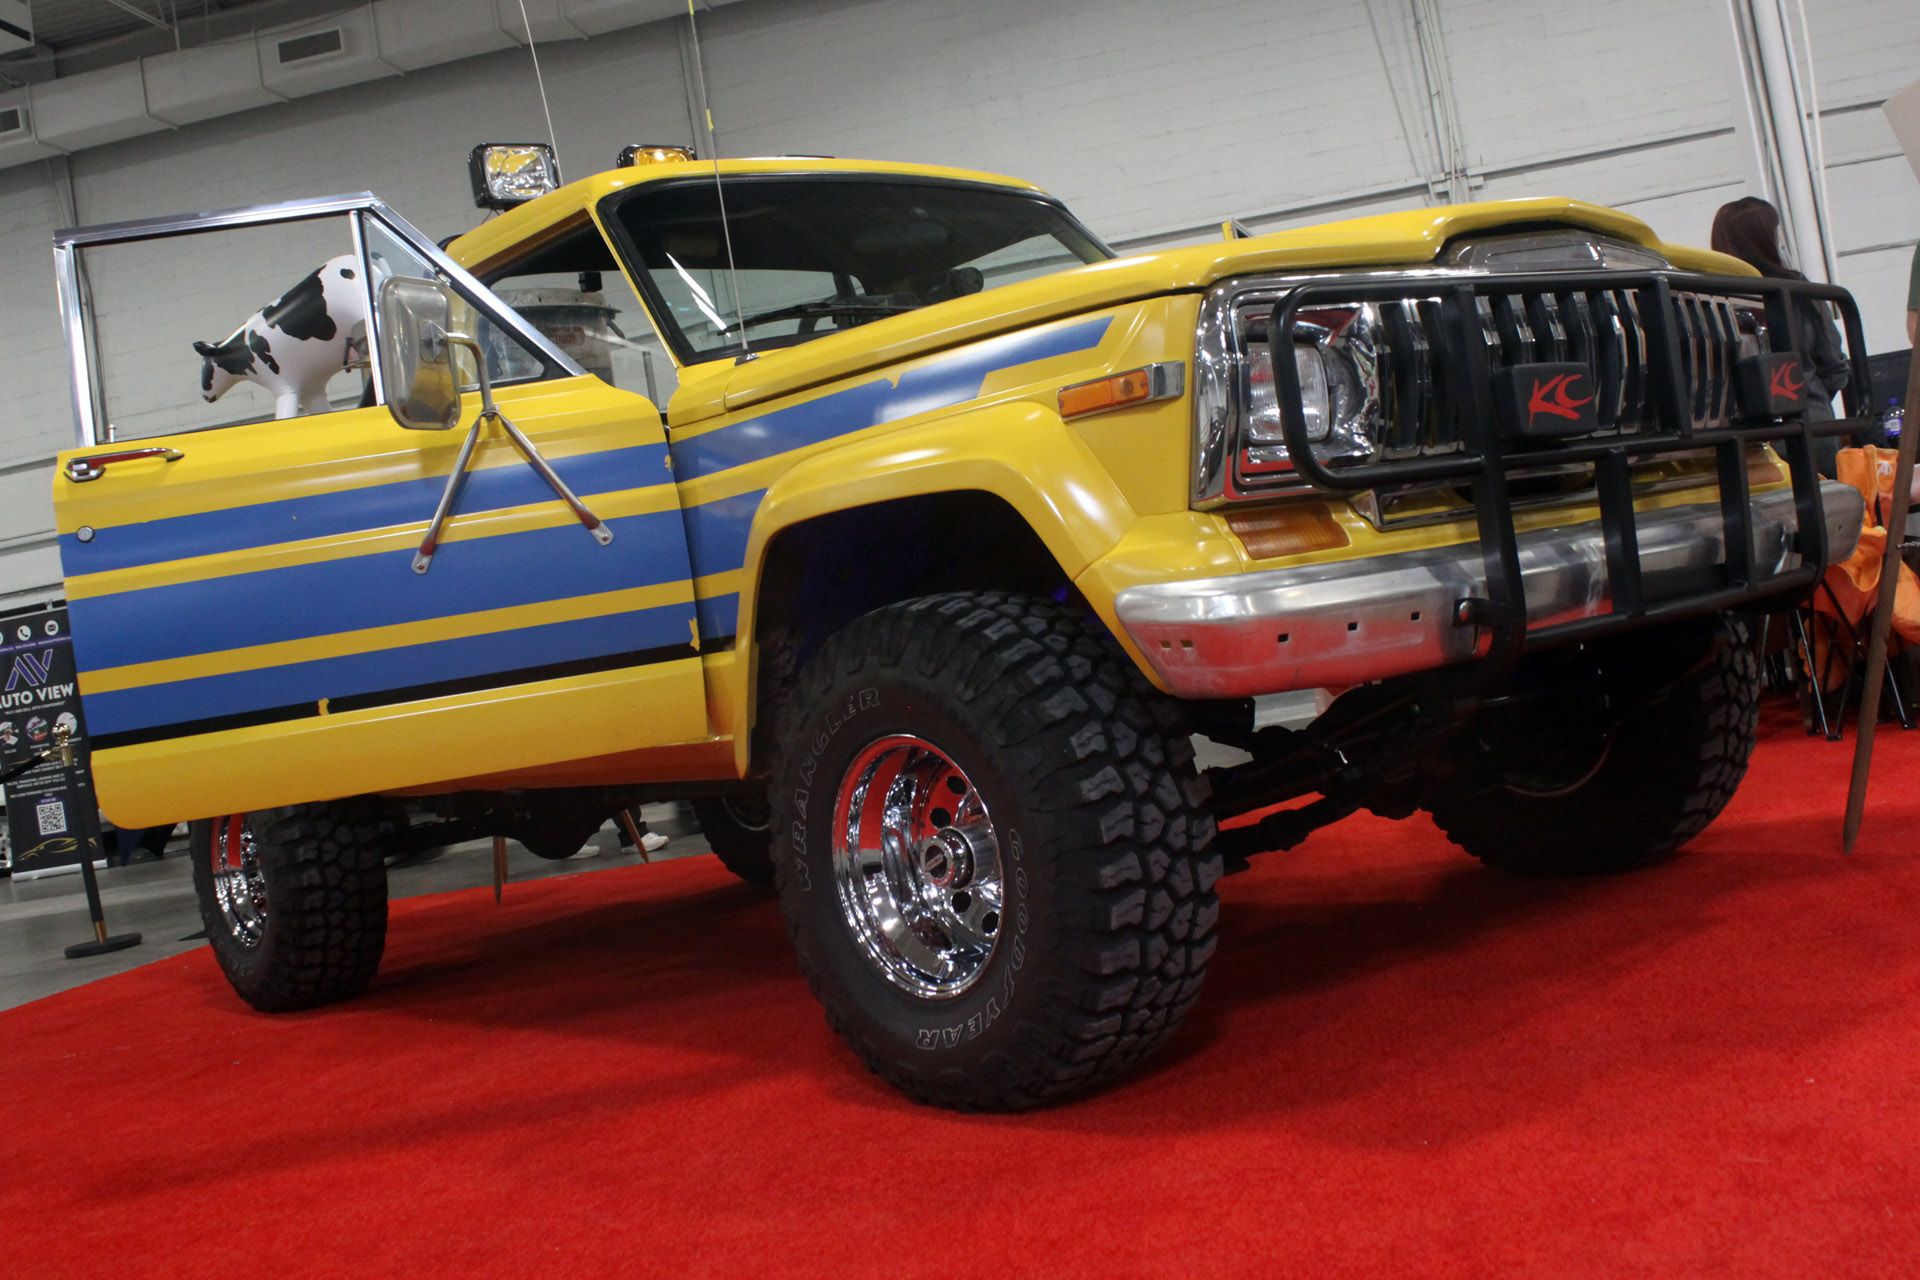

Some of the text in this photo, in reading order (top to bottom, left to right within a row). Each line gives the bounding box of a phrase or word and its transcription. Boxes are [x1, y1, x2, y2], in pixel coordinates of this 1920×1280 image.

[1528, 374, 1593, 427] KC
[1770, 362, 1805, 405] KC
[0, 691, 33, 709] UTO
[36, 682, 74, 702] VIEW
[793, 688, 881, 892] WRANGLER
[917, 829, 1029, 1050] GOODYEAR
